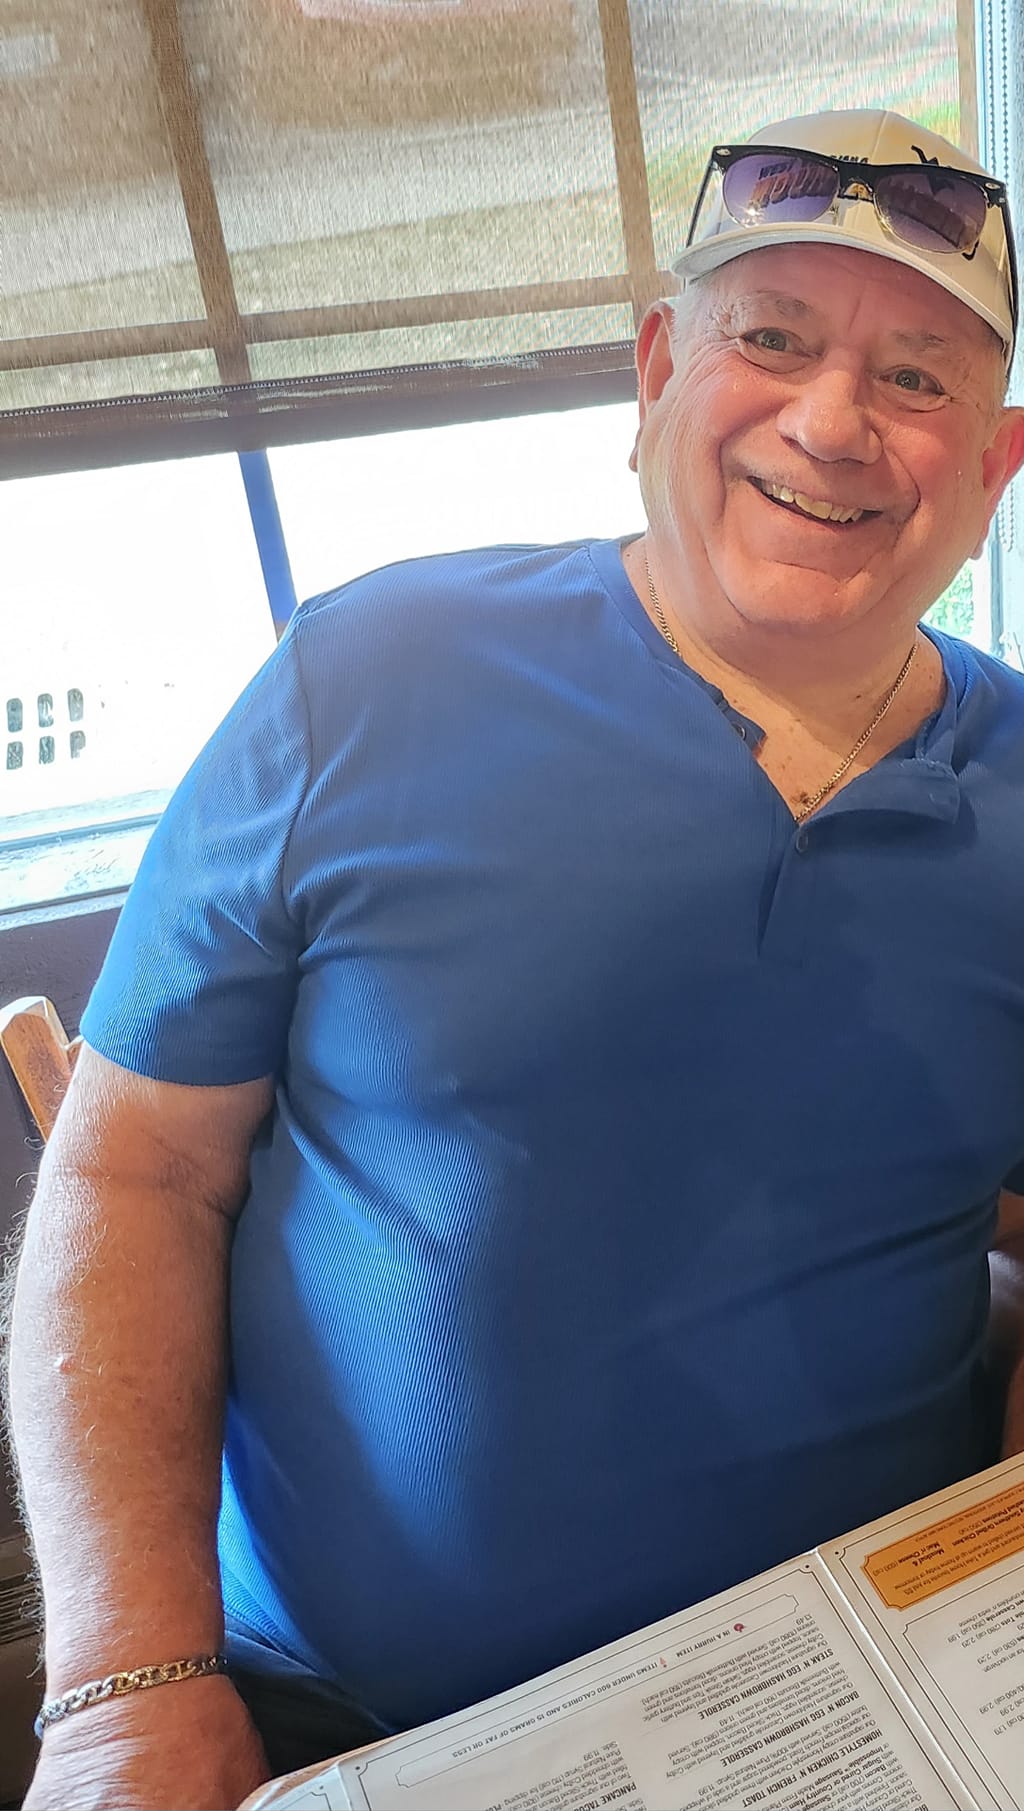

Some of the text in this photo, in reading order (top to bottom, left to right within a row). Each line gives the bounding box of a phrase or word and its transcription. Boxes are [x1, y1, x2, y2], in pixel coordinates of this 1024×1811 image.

[694, 1636, 716, 1650] HURRY
[676, 1646, 693, 1657] ITEM
[636, 1662, 658, 1675] ITEMS
[612, 1672, 636, 1686] UNDER
[698, 1648, 833, 1720] STEAK N' EGG HASHBROWN CASSEROLE
[596, 1683, 611, 1693] 600
[562, 1690, 596, 1709] CALORIES
[546, 1706, 560, 1717] AND
[509, 1718, 535, 1733] GRAMS
[720, 1691, 859, 1767] BACON N' EGG HASHBROWN CASSEROLE
[485, 1734, 498, 1744] FAT
[500, 1730, 509, 1738] OF
[472, 1741, 483, 1749] OR
[452, 1746, 472, 1758] LESS
[742, 1729, 882, 1808] HOMESTYLE CHICKEN N' FRENCH TOAST
[862, 1757, 882, 1770] Sugar
[841, 1768, 862, 1783] Cured
[600, 1782, 636, 1804] PANCAKE
[806, 1784, 833, 1800] Country
[788, 1798, 806, 1809] Ham
